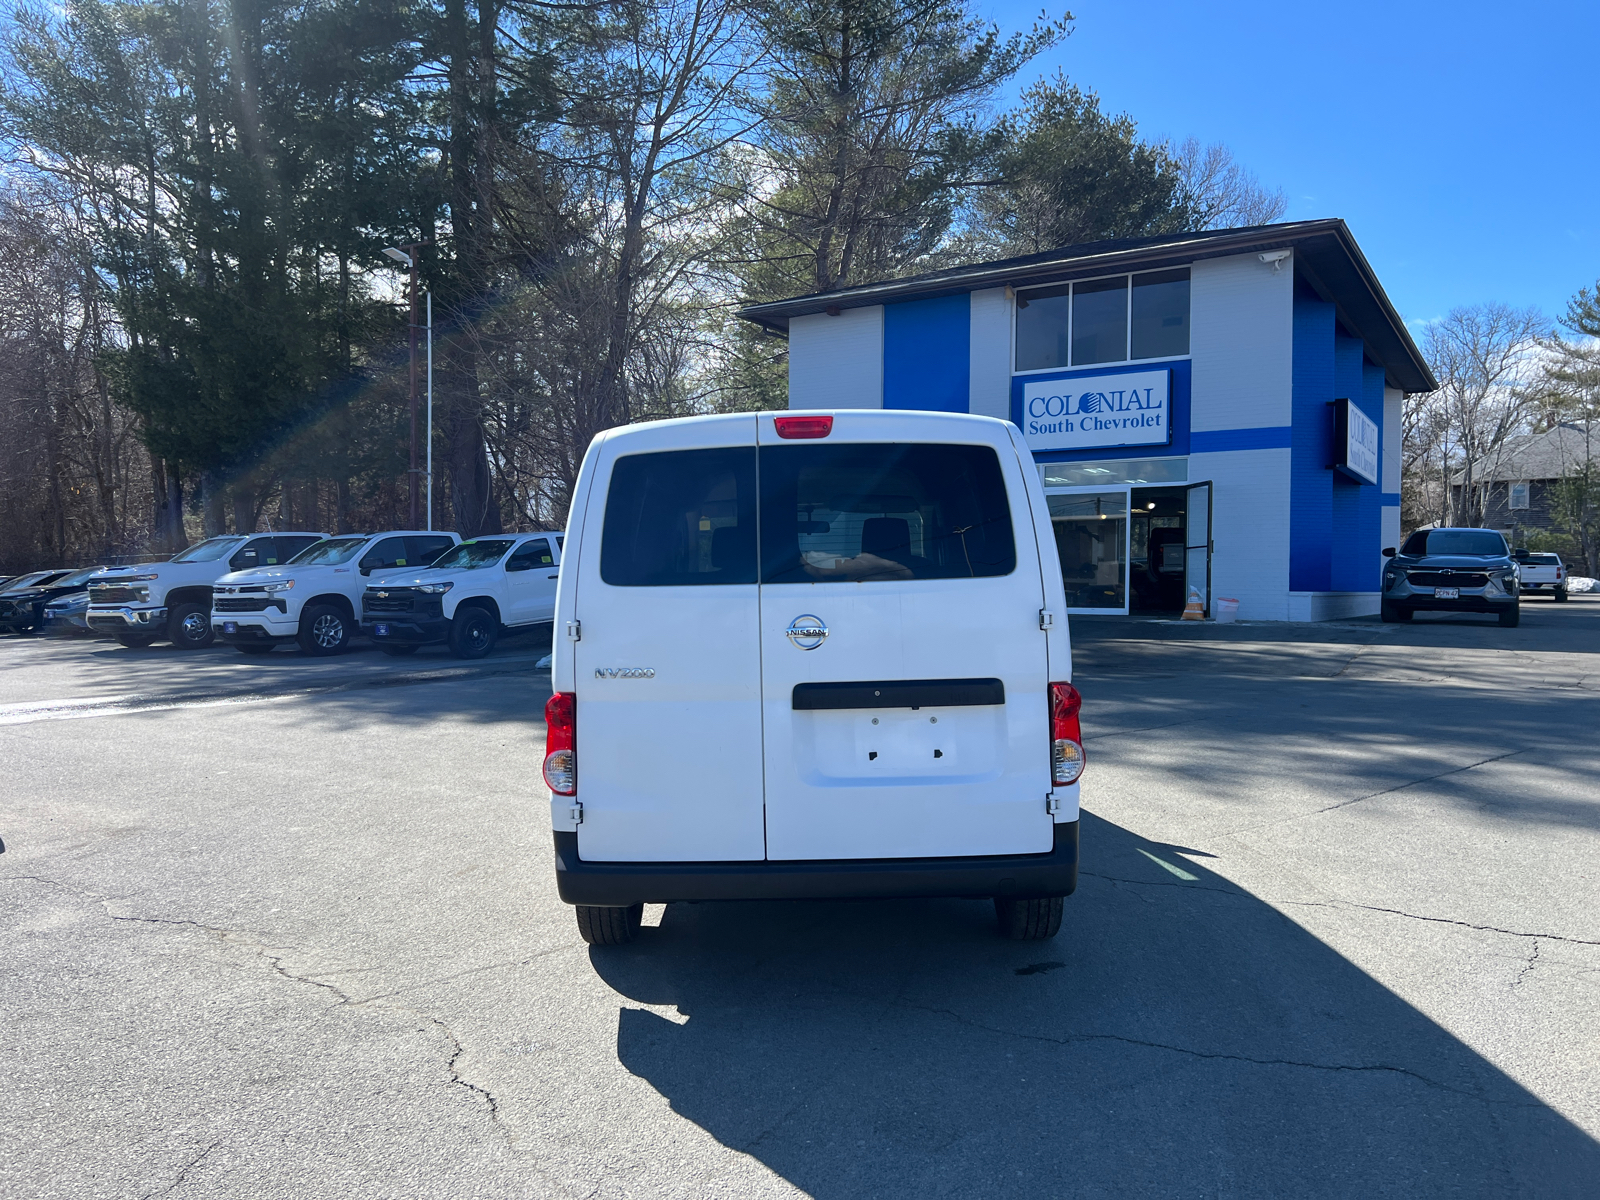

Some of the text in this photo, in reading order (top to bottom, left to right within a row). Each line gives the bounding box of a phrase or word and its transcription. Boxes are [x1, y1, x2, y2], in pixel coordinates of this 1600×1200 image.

[1029, 413, 1162, 435] South Chevrolet
[594, 667, 655, 679] NV200
